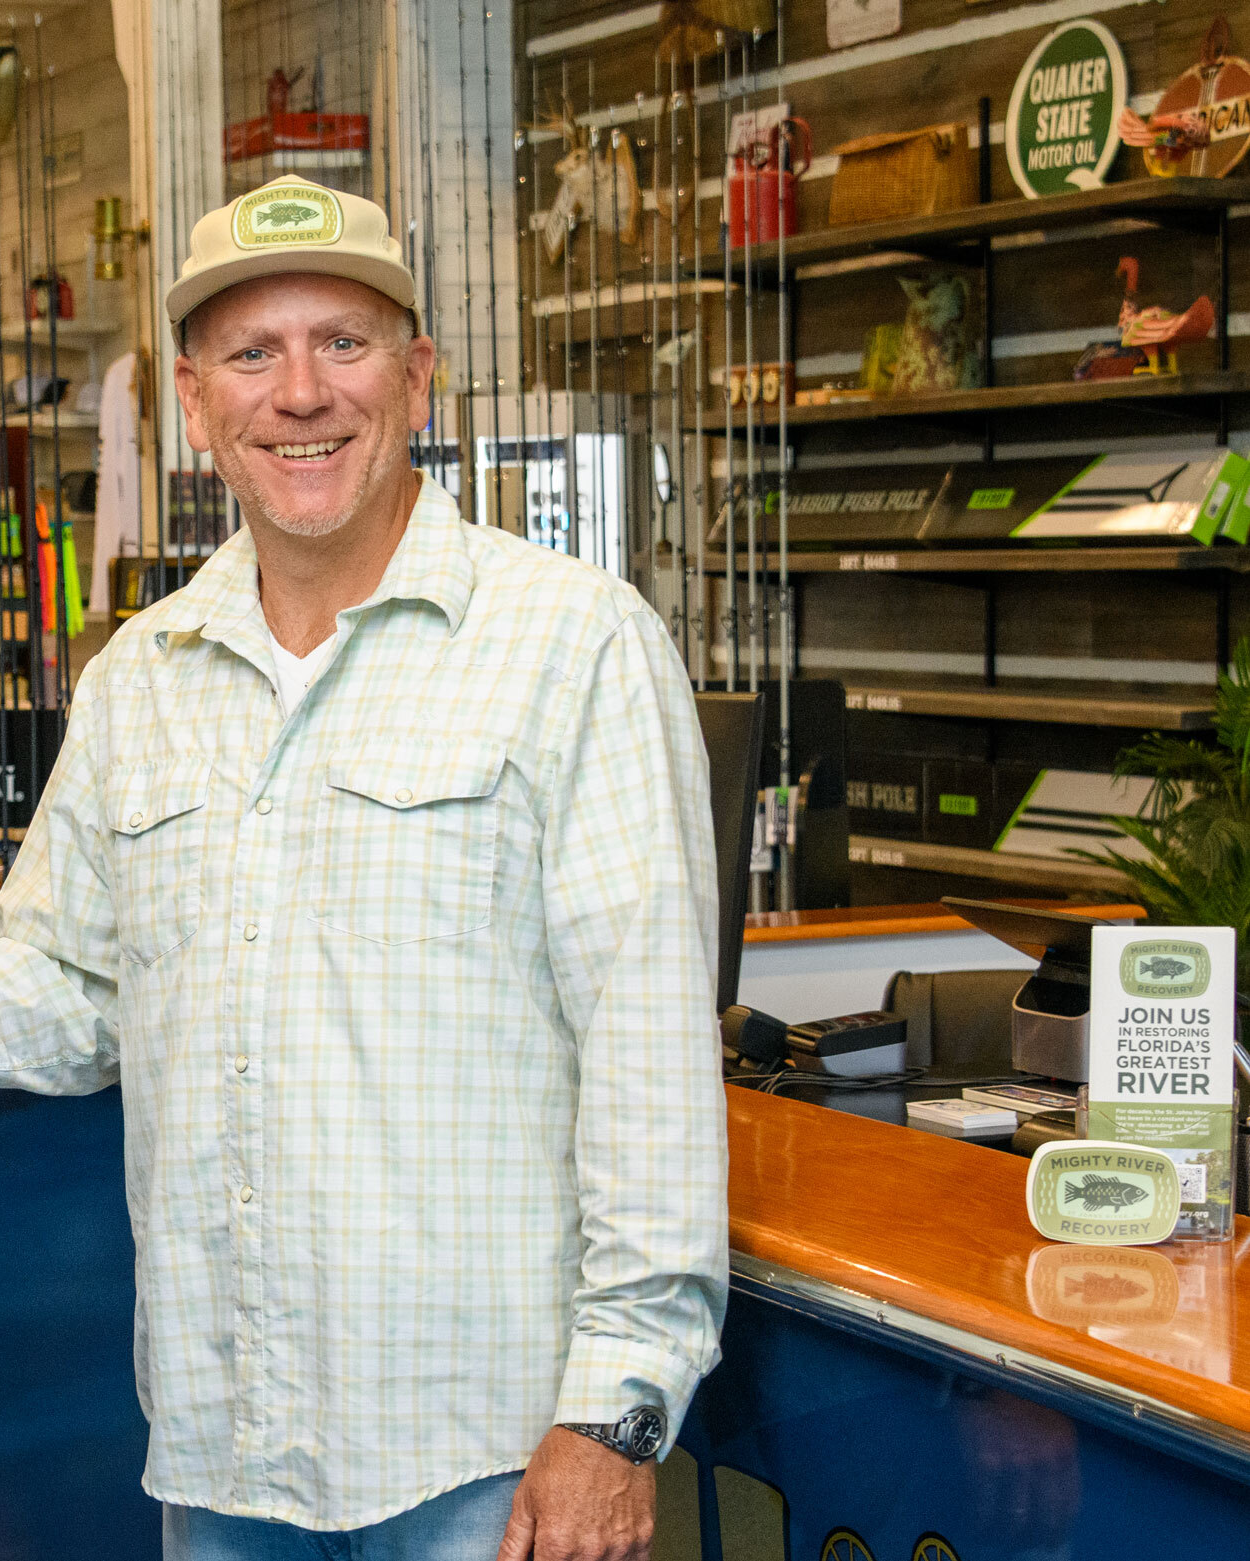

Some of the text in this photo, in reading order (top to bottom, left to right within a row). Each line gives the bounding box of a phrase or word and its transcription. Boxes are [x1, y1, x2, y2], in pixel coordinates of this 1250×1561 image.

[1029, 56, 1109, 105] QUAKER
[1035, 99, 1094, 143] STATE
[1028, 138, 1097, 172] MOTOR OIL
[245, 189, 329, 208] MIGHTY RIVER
[254, 231, 323, 243] RECOVERY
[884, 488, 930, 511] POLE
[871, 782, 918, 814] POLE
[1131, 944, 1202, 955] MIGHTY RIVER
[1137, 984, 1193, 995] RECOVERY
[1118, 1007, 1210, 1025] JOIN US
[1118, 1027, 1210, 1038] IN RESTORING
[1117, 1039, 1211, 1053] FLORIDA'S
[1116, 1055, 1211, 1070] GREATEST
[1117, 1072, 1210, 1095] RIVER
[1051, 1155, 1166, 1174] MIGHTY RIVER
[1060, 1220, 1151, 1236] RECOVERY
